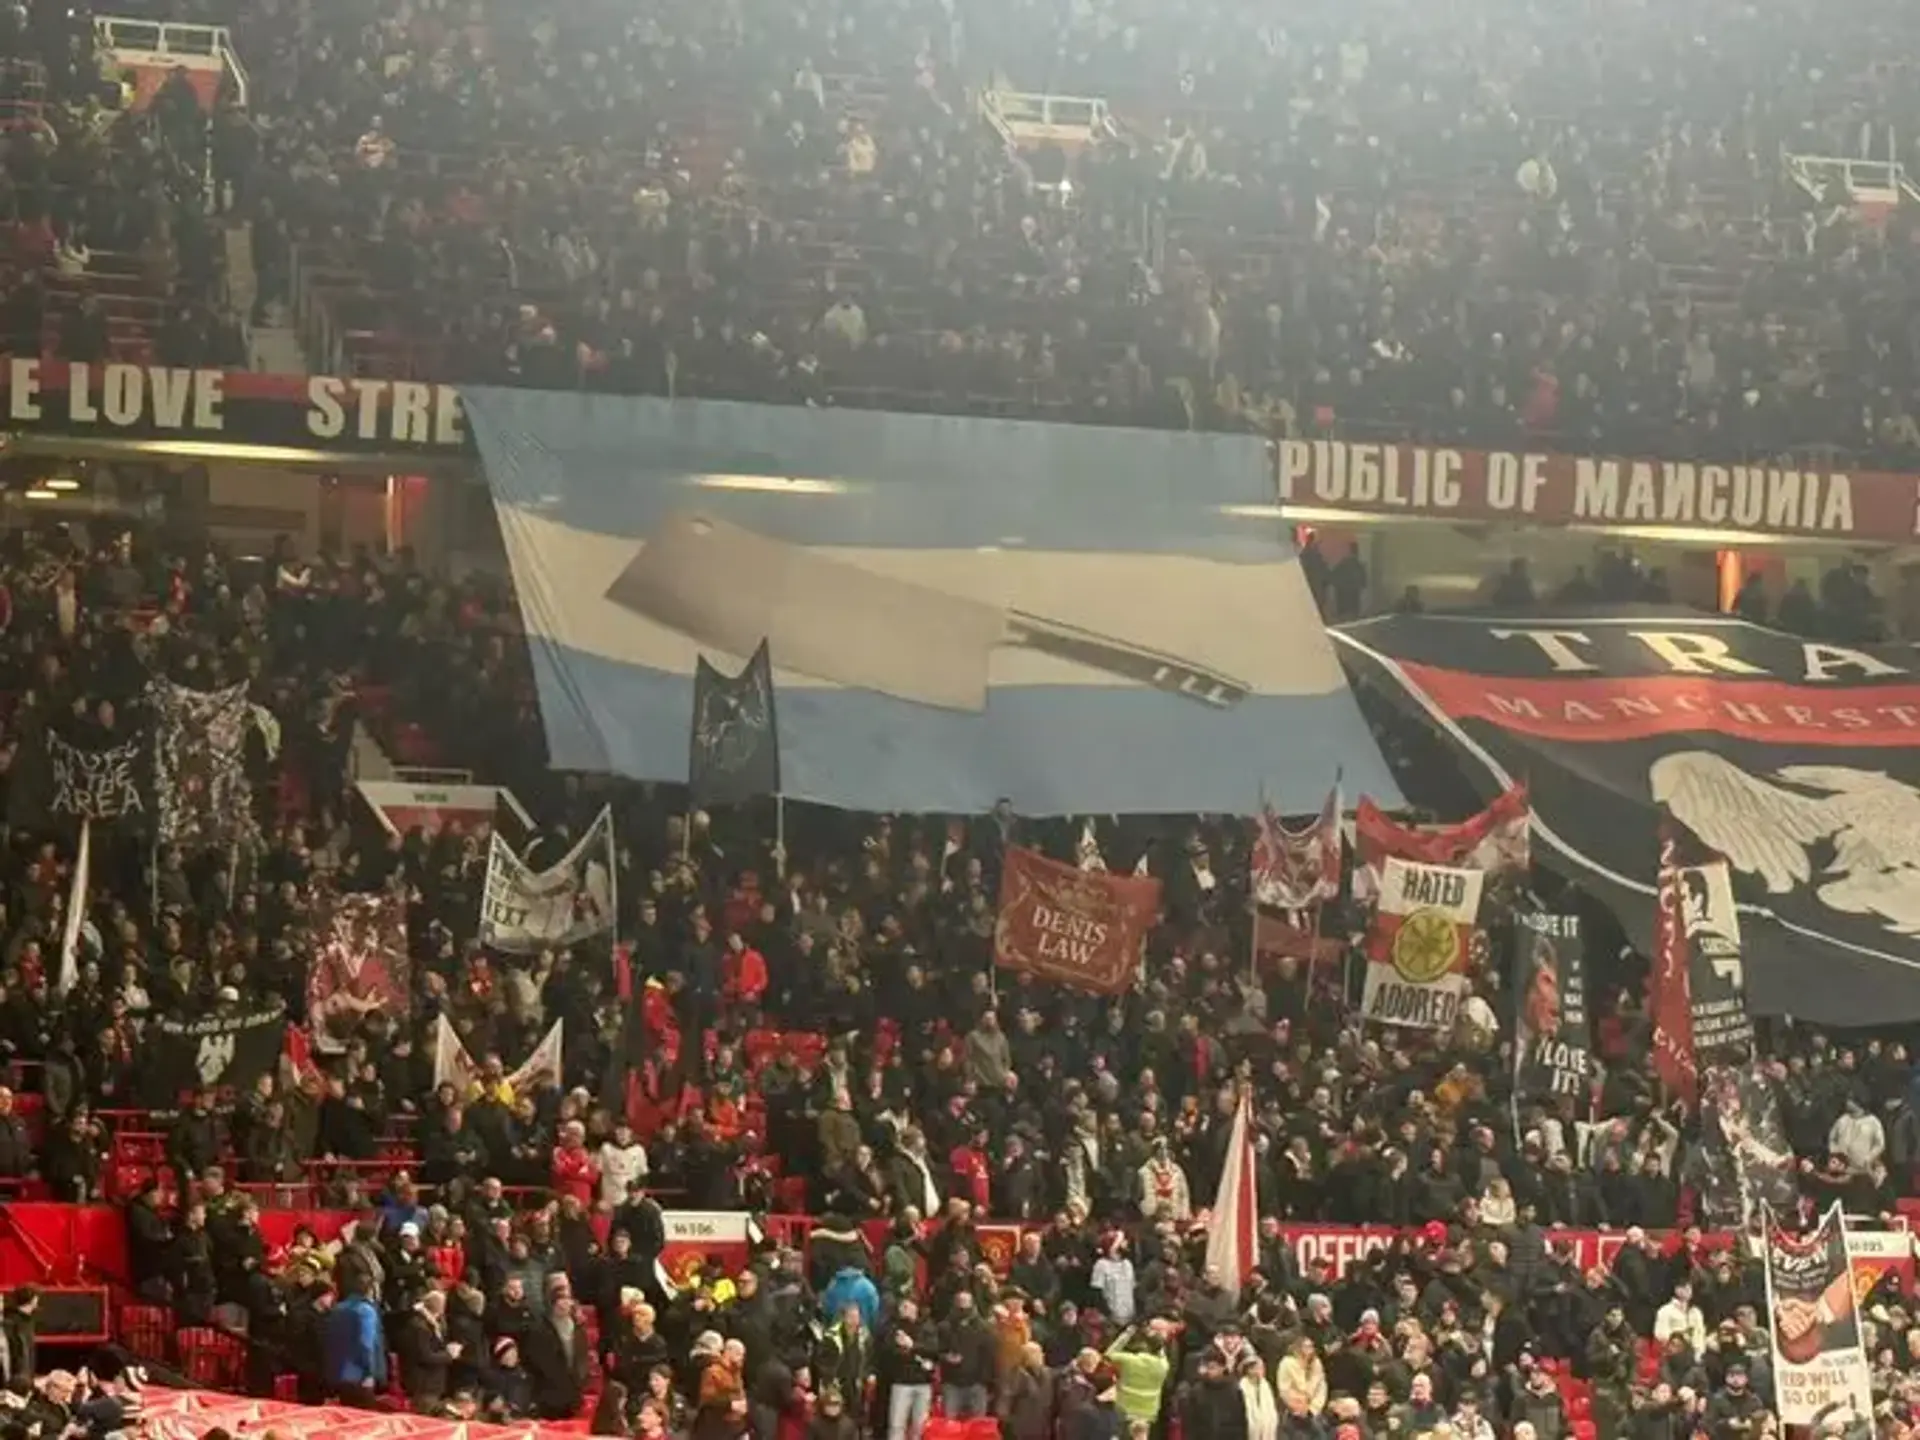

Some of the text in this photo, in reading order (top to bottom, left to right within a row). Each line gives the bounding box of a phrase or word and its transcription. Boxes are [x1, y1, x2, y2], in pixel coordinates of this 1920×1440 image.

[10, 358, 464, 444] E LOVE STRE
[1487, 451, 1548, 513] OF
[50, 781, 145, 818] AREA
[1401, 866, 1467, 906] HATED
[1032, 904, 1109, 945] DENIS
[1038, 931, 1098, 965] LAW
[1370, 981, 1460, 1022] ADORED
